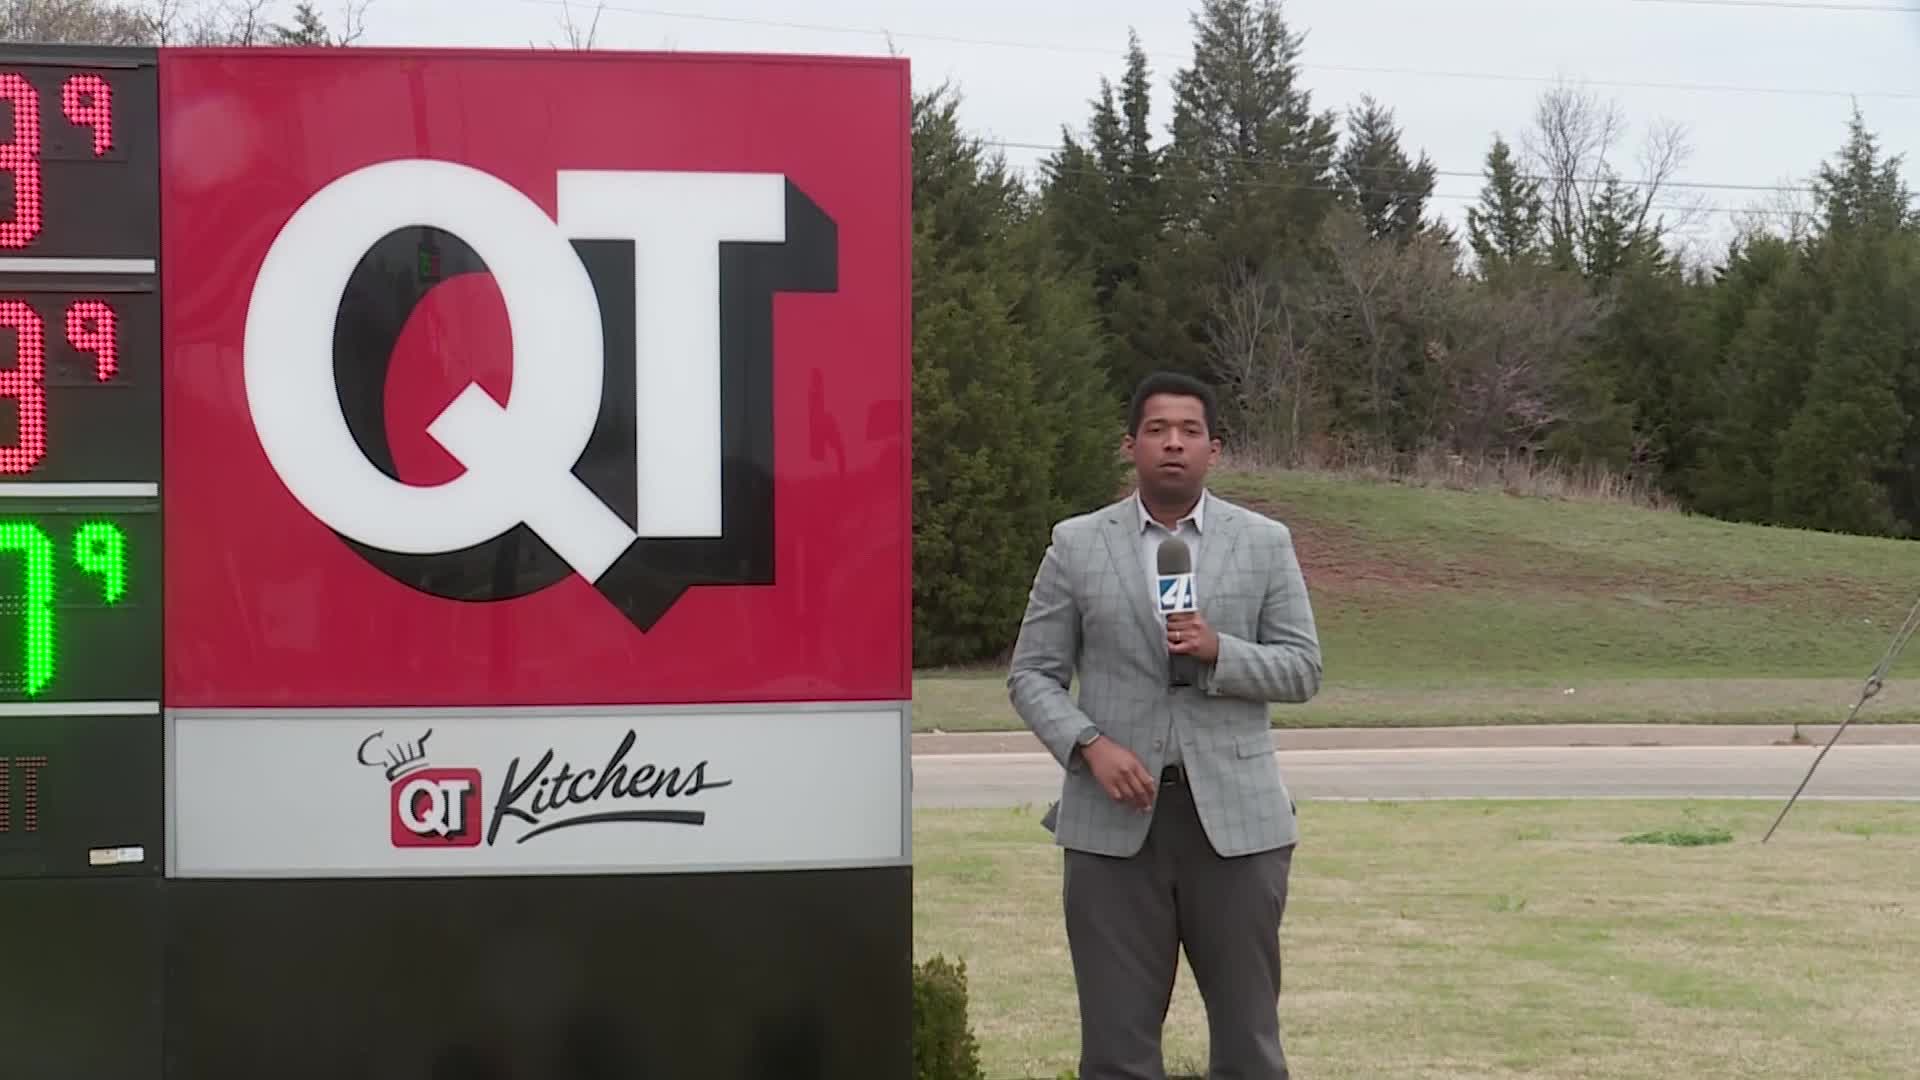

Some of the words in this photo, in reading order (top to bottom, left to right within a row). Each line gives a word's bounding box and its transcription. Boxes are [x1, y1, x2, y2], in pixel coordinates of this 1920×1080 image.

[243, 158, 790, 590] QT
[1160, 575, 1192, 610] 4
[398, 778, 476, 840] QT
[487, 729, 732, 846] Kitchens
